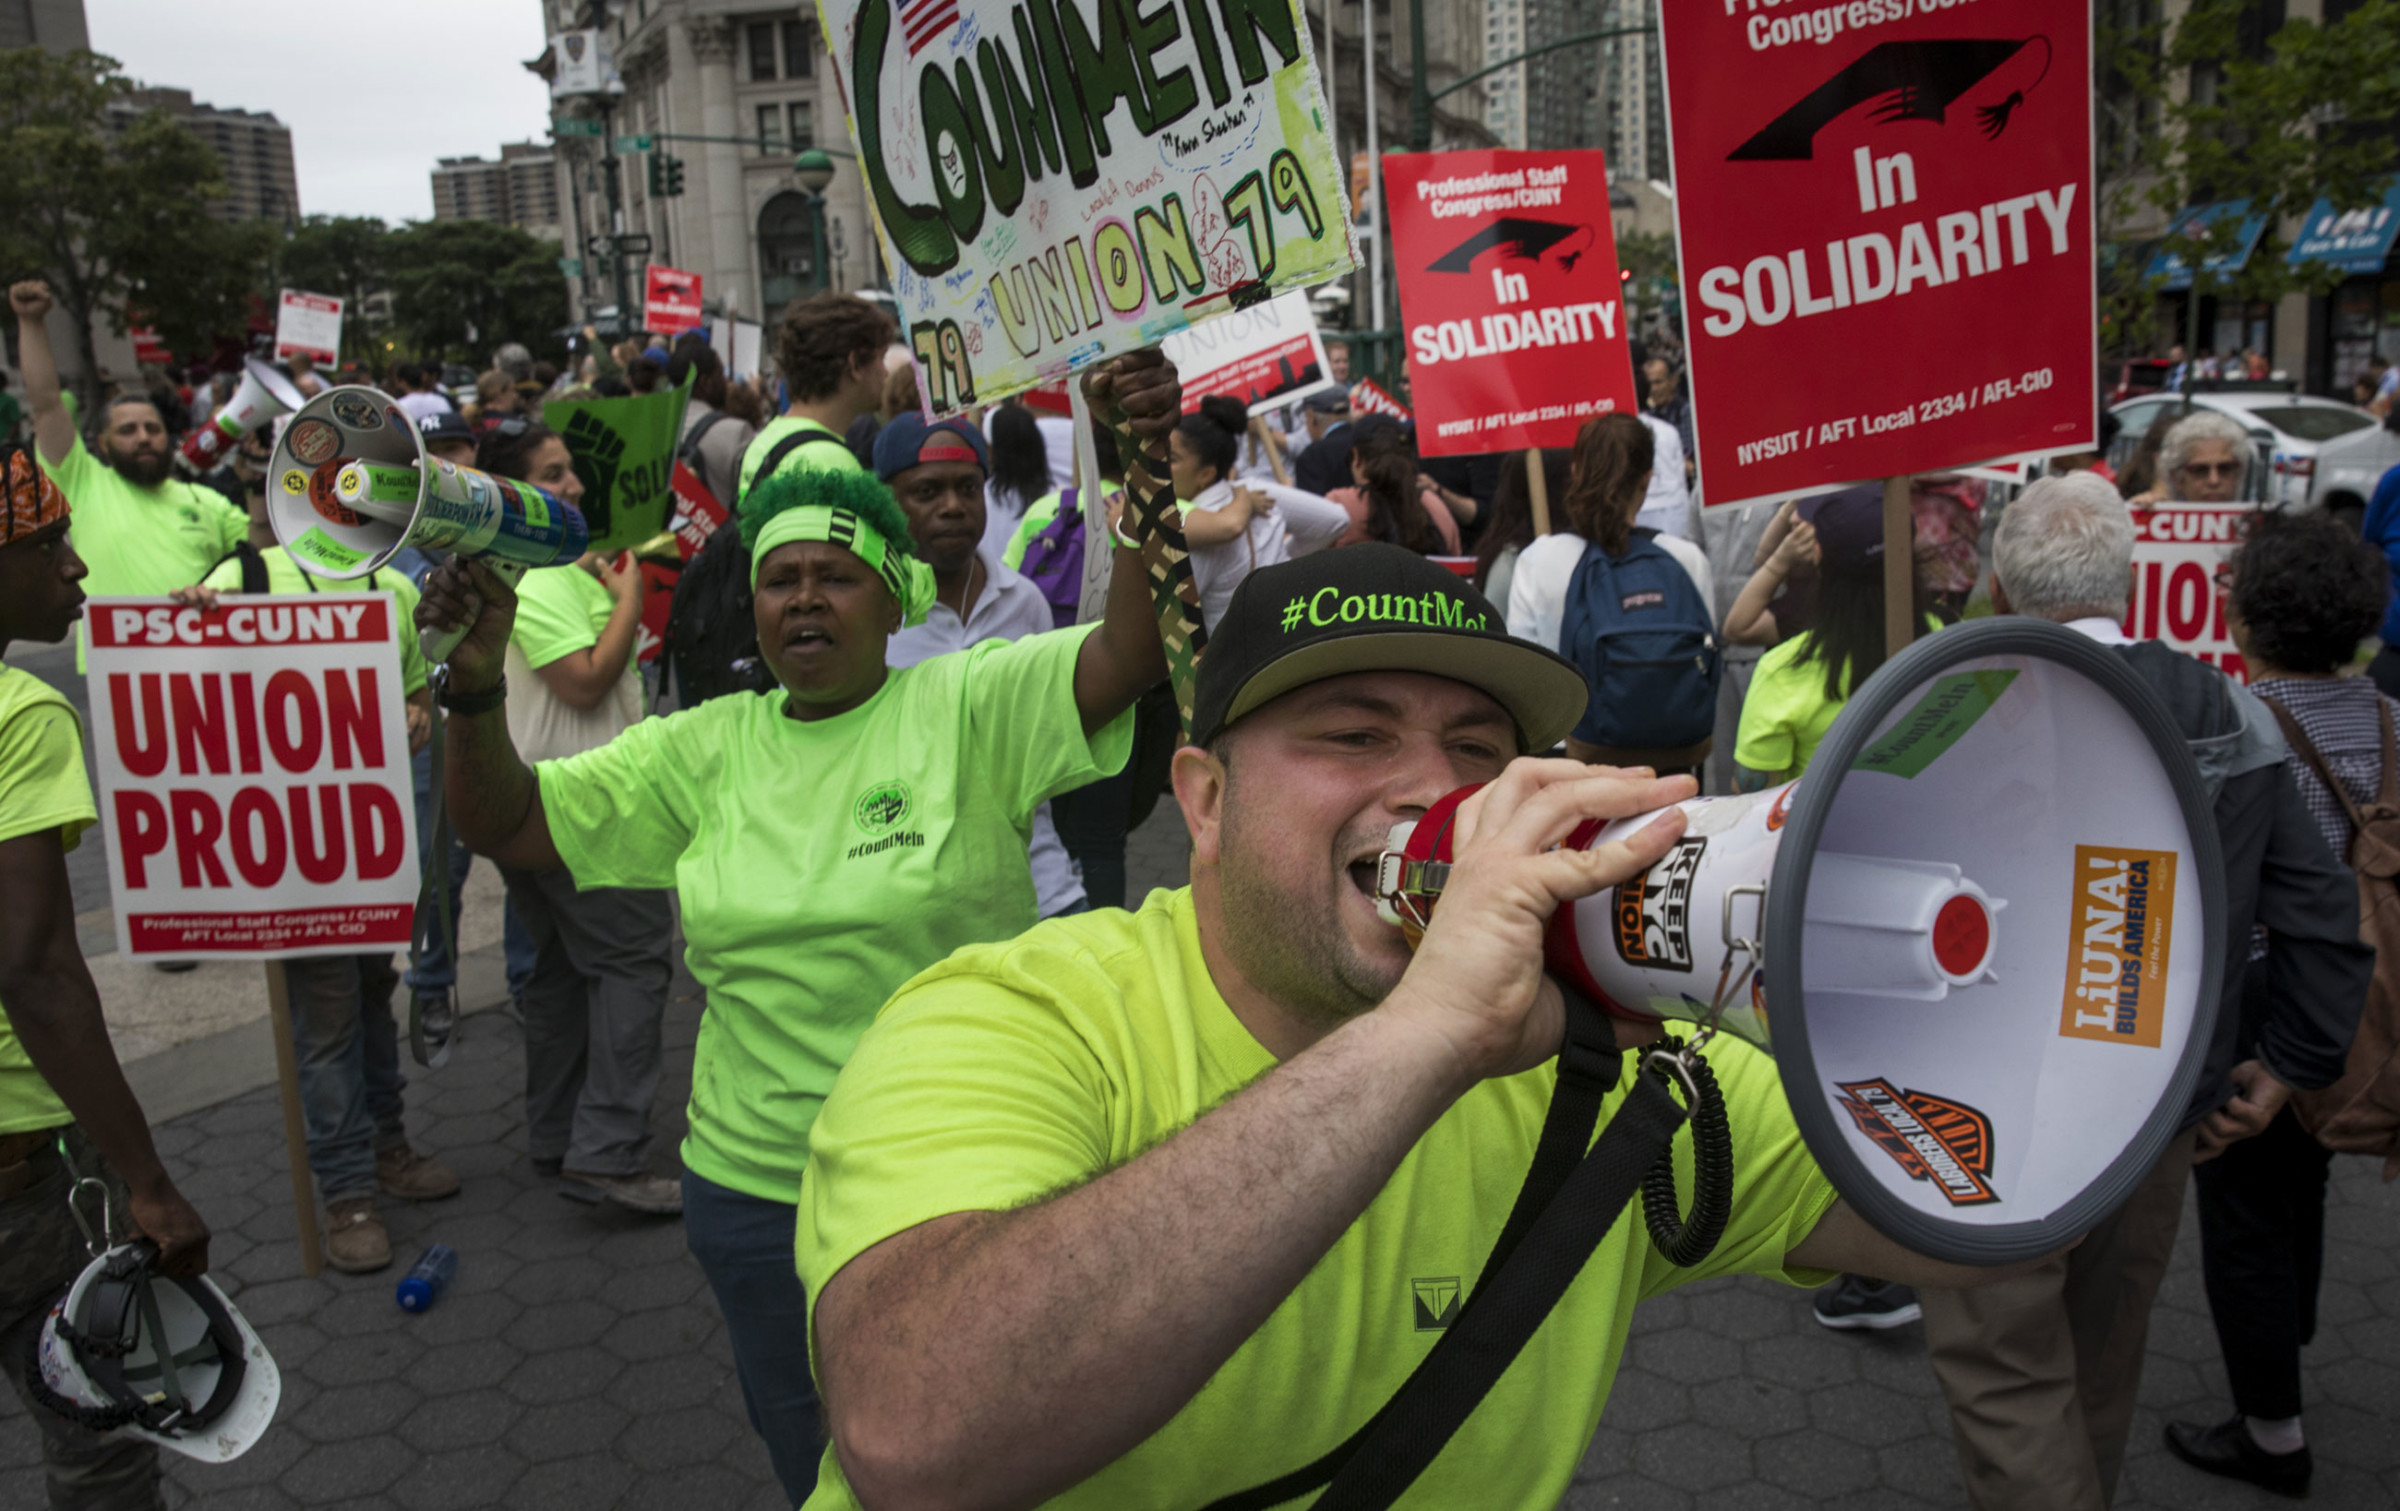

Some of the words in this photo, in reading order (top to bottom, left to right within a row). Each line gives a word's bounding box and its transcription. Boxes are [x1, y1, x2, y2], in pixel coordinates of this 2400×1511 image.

[1416, 168, 1525, 201] Professional
[1527, 164, 1568, 187] Staff
[1430, 186, 1562, 219] Congress/CUNY
[1853, 145, 1918, 213] In
[988, 190, 1205, 359] UNION
[1223, 147, 1325, 282] 79
[1698, 182, 2078, 338] SOLIDARITY
[1491, 267, 1530, 305] In
[1411, 300, 1616, 366] SOLIDARITY
[909, 317, 978, 414] 79
[1437, 417, 1475, 438] NYSUT
[1485, 414, 1507, 430] AFT
[1509, 408, 1539, 427] Local
[1540, 404, 1567, 422] 2334
[1574, 397, 1616, 417] AFL-CIO
[1737, 430, 1800, 466] NYSUT
[1805, 426, 1814, 449] /
[1819, 417, 1858, 445] AFT
[1862, 405, 1915, 436] Local
[1919, 392, 1966, 423] 2334
[1970, 387, 1979, 409] /
[1982, 367, 2054, 406] AFL-CIO
[111, 604, 367, 644] PSC-CUNY
[108, 666, 386, 778] UNION
[113, 782, 406, 889] PROUD
[847, 830, 925, 861] #CountMeIn
[142, 917, 233, 931] Professional
[236, 915, 271, 929] Staff
[274, 911, 346, 928] Congress
[357, 907, 400, 921] CUNY
[182, 930, 211, 942] AFT
[214, 930, 254, 941] Local
[256, 927, 291, 941] 2334
[304, 925, 336, 939] AFL
[1667, 846, 1700, 960] KEEP
[2123, 859, 2150, 957] AMERICA
[2151, 916, 2163, 946] Power
[2074, 857, 2130, 1032] LiUNA!
[2148, 963, 2160, 981] Feel
[2150, 946, 2161, 963] the
[2115, 959, 2142, 1035] BUILDS
[1873, 1103, 1925, 1134] LOCAL
[1905, 1134, 1981, 1196] LABORERS
